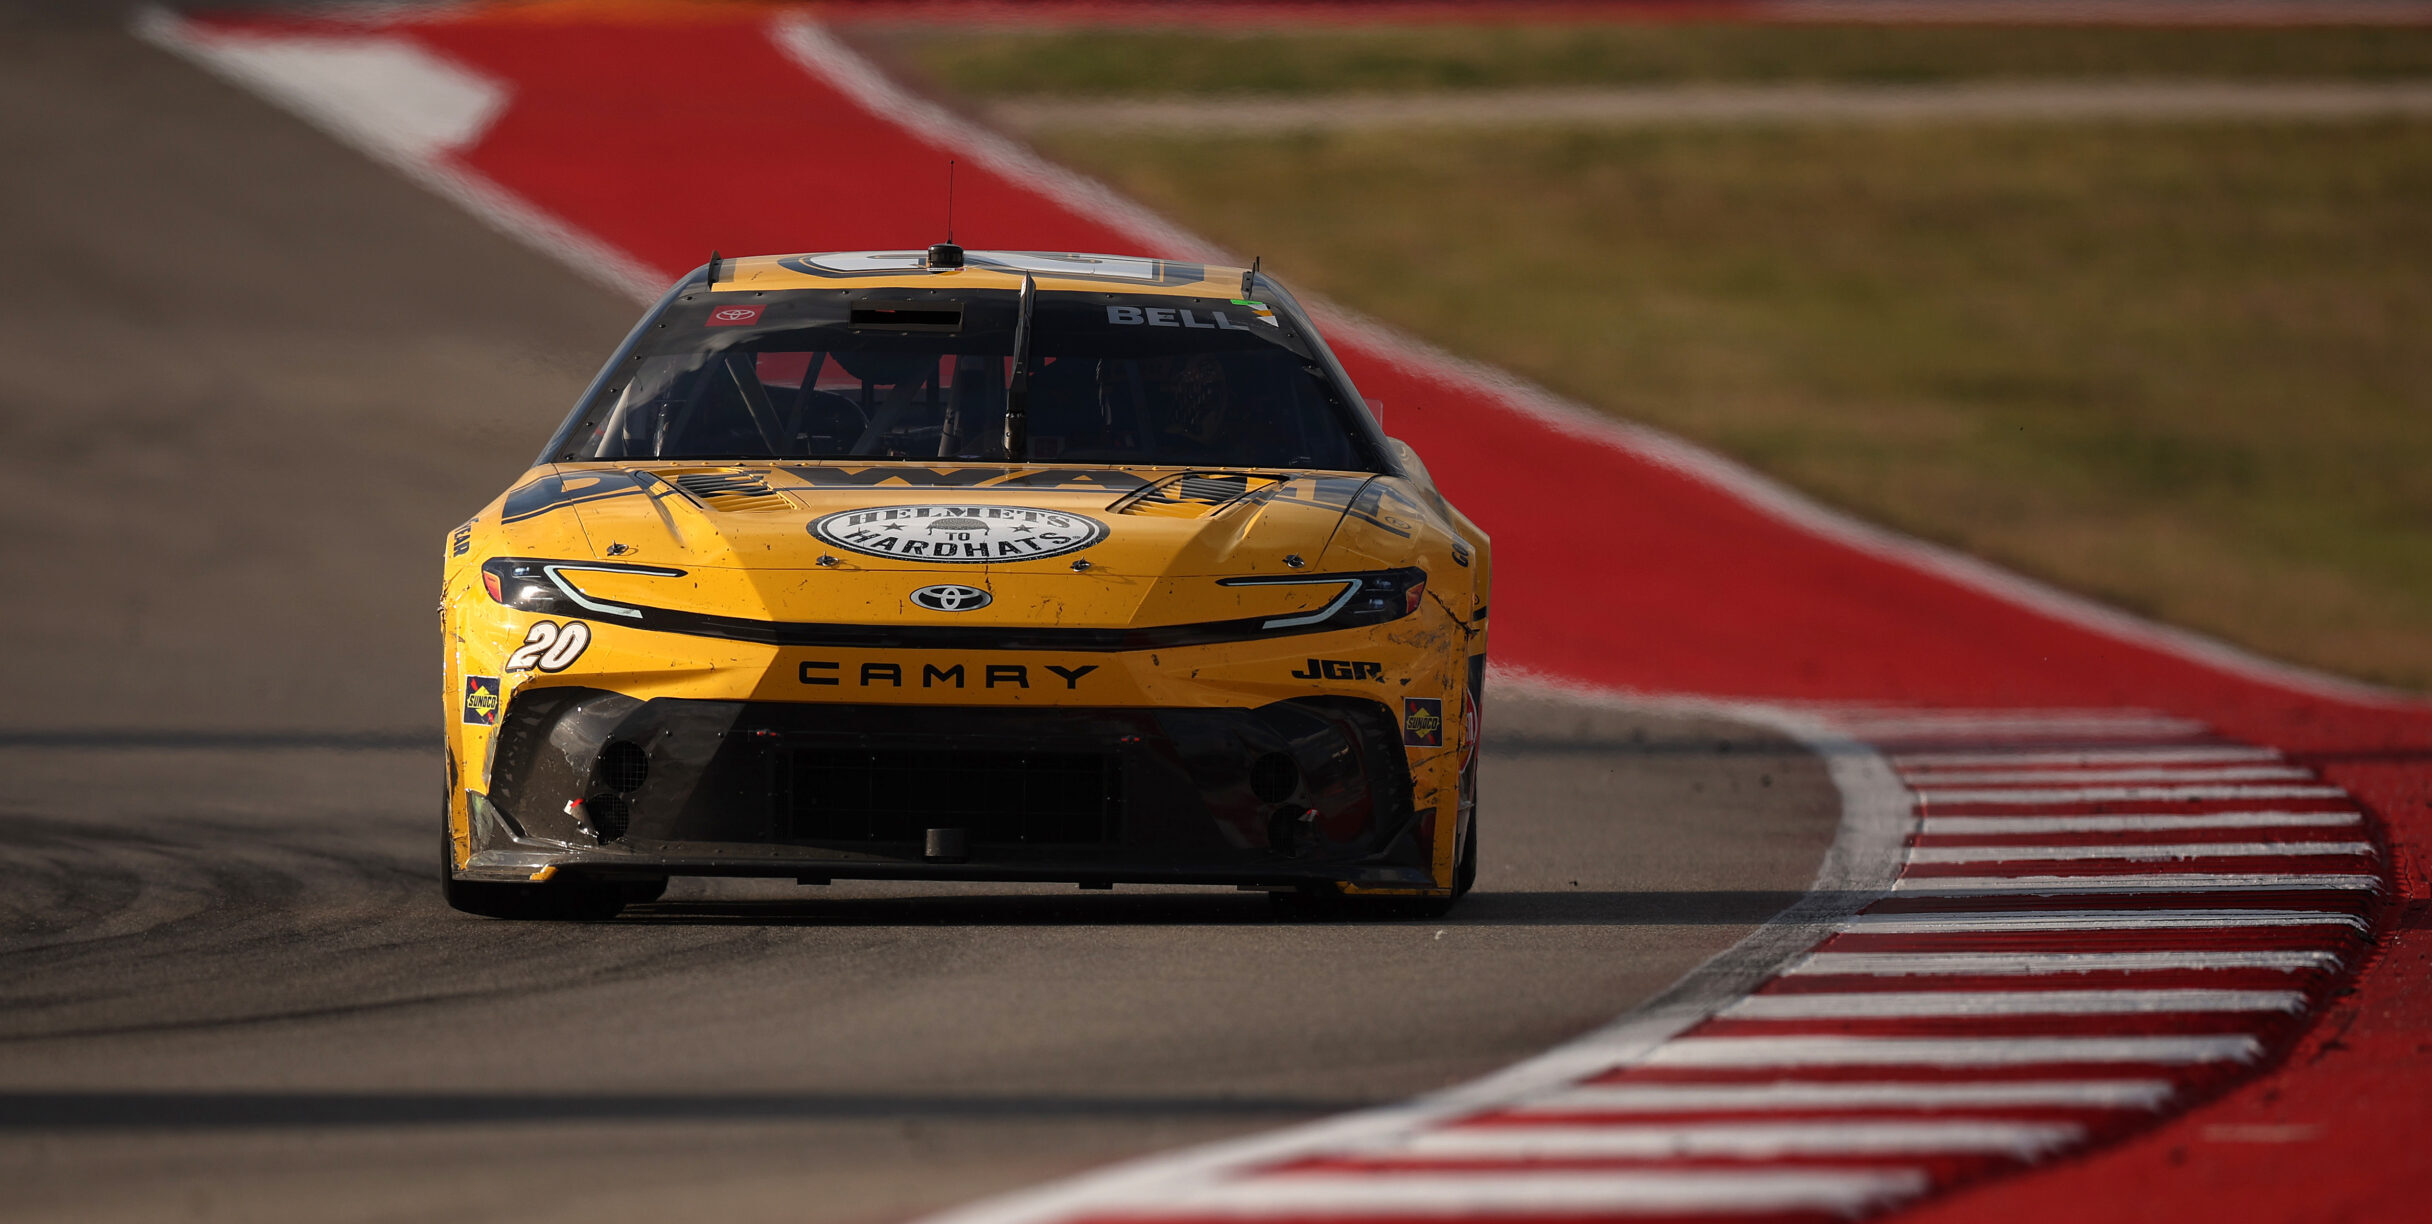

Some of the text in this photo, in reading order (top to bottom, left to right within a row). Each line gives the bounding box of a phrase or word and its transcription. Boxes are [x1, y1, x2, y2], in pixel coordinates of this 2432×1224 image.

[1106, 305, 1250, 332] BELL
[847, 506, 1071, 529] HELMETS
[843, 528, 1079, 558] HARDHATS
[944, 531, 971, 542] TO
[505, 619, 592, 674] 20
[798, 660, 1100, 690] CAMRY
[1290, 657, 1386, 684] JGR
[467, 694, 497, 709] SUNOCO
[1406, 716, 1439, 731] SUNOCO
